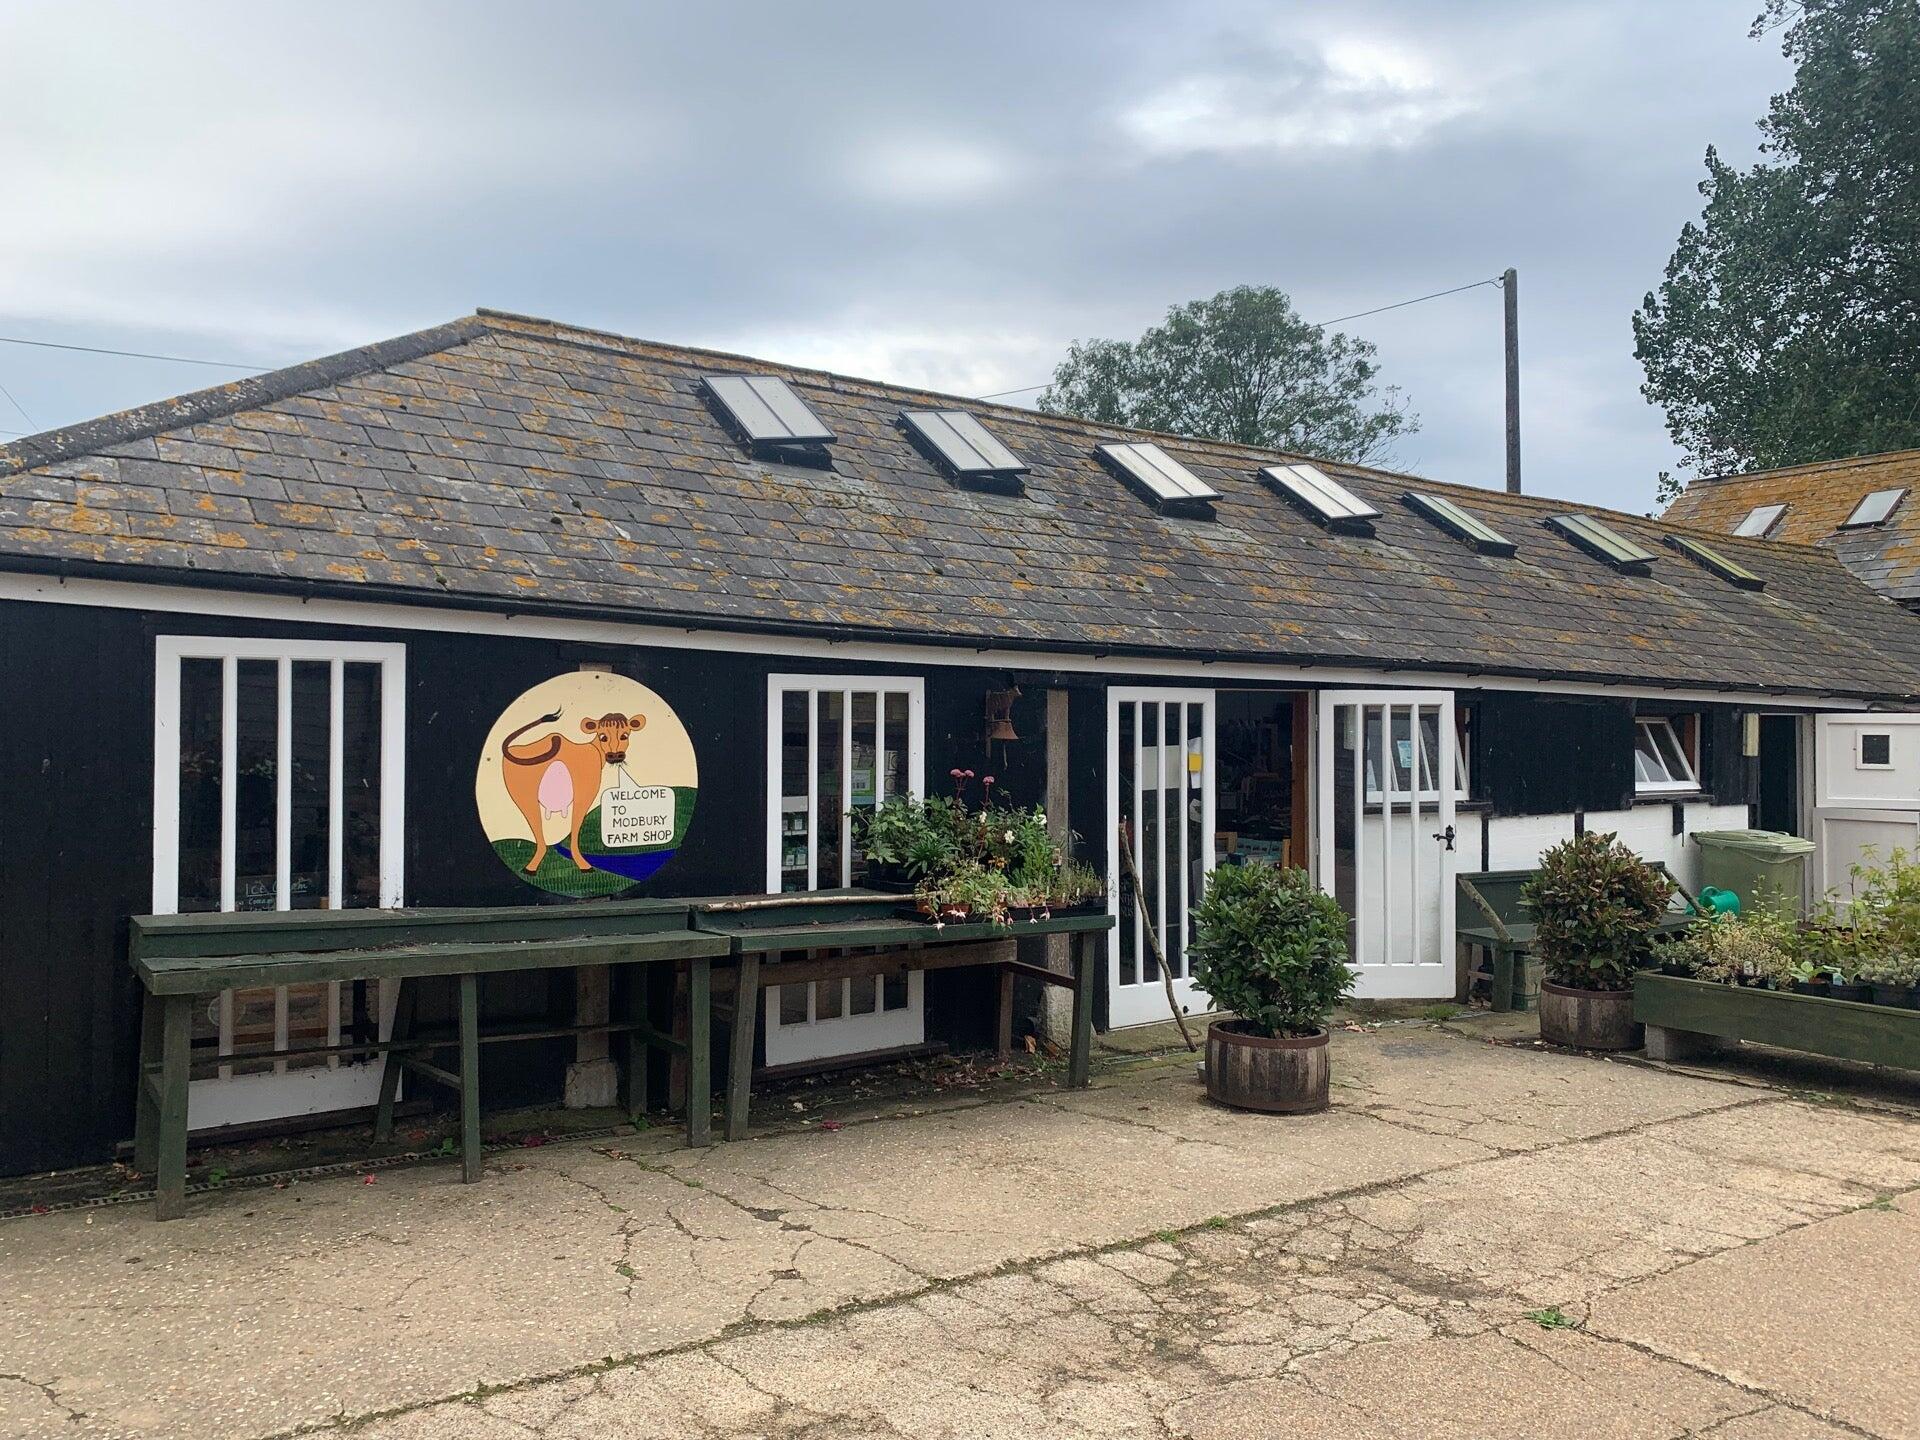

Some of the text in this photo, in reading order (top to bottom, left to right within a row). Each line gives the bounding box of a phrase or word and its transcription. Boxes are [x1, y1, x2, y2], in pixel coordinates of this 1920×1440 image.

[610, 789, 666, 800] WELCOME
[611, 805, 627, 816] TO
[612, 815, 668, 828] MODBURY
[607, 829, 672, 844] FARM SHOP
